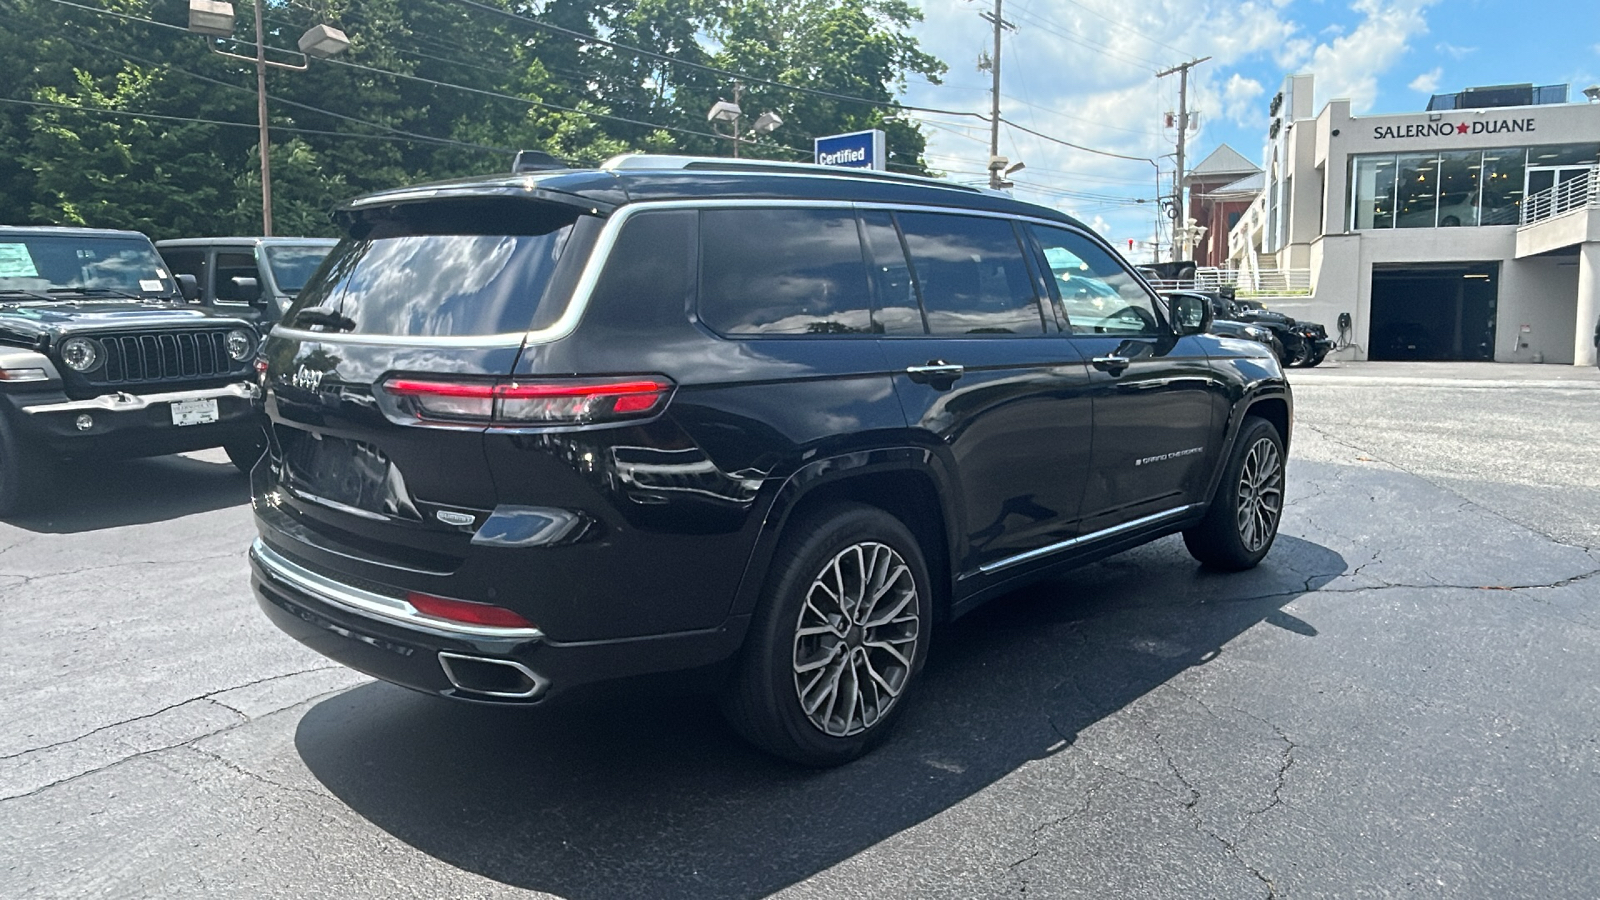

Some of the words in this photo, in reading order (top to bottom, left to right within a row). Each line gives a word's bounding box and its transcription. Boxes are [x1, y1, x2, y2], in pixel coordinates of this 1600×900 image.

[1374, 122, 1454, 139] SALERNO
[1472, 118, 1535, 134] DUANE
[819, 147, 865, 166] Certified
